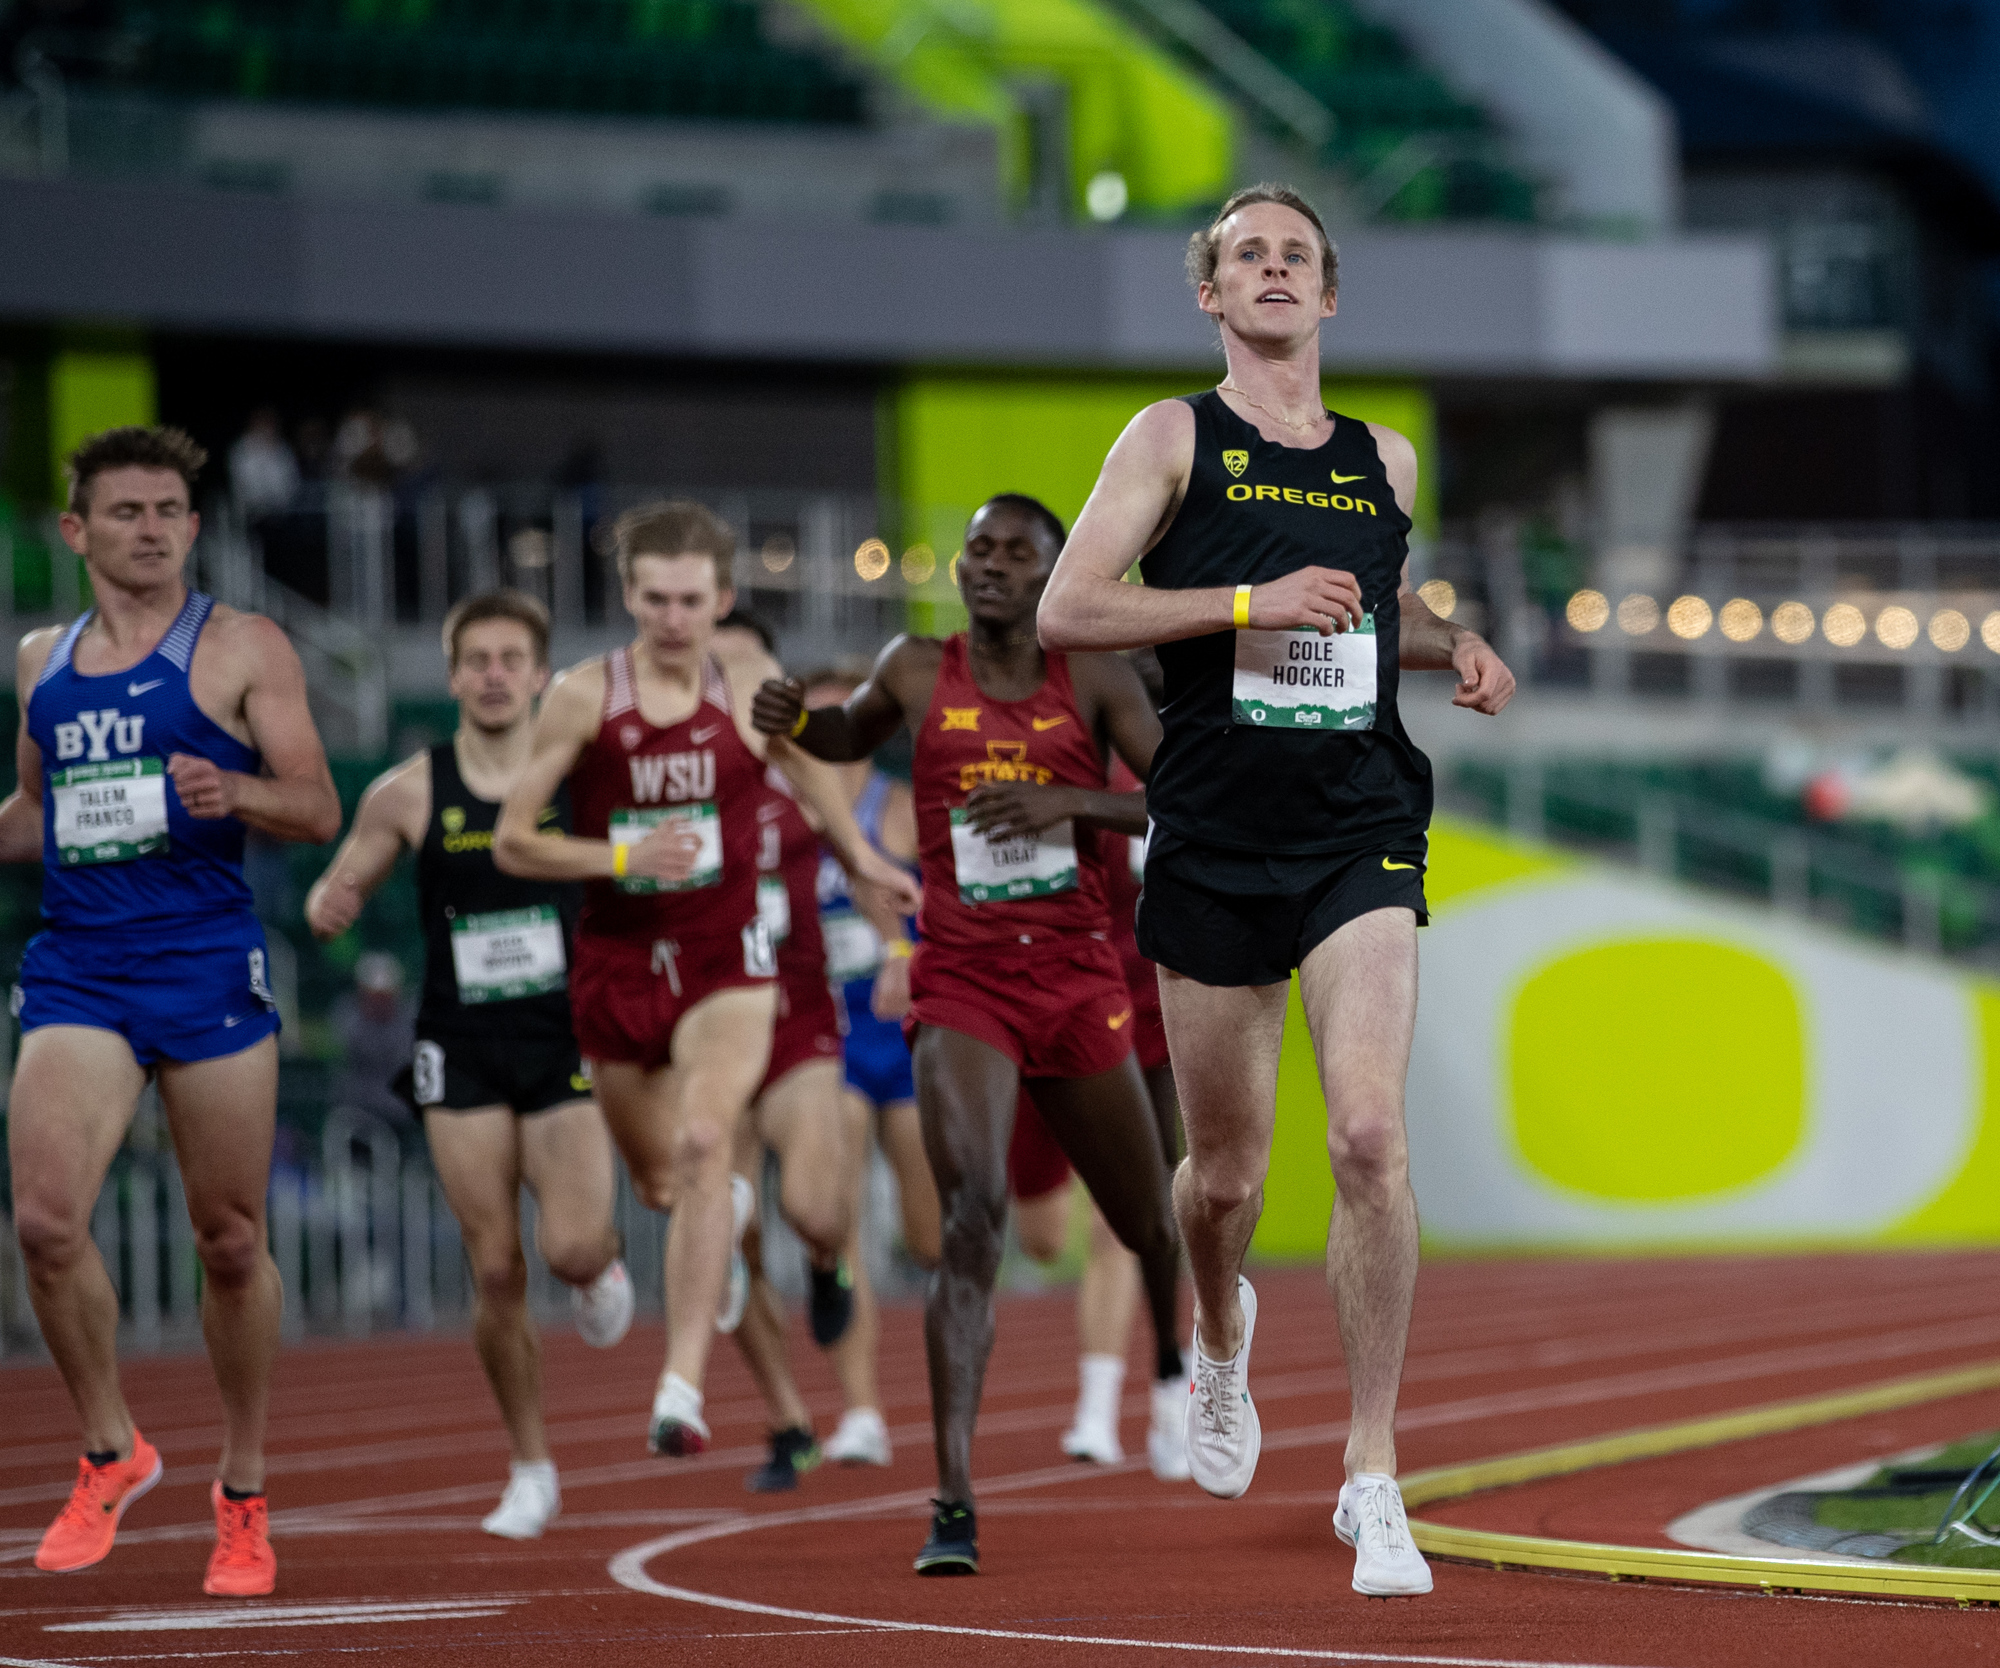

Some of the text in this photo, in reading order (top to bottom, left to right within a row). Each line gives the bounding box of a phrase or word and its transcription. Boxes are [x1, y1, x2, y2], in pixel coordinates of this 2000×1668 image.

[1230, 460, 1243, 472] 12
[1226, 483, 1378, 516] OREGON
[1288, 640, 1333, 662] COLE
[1272, 665, 1345, 688] HOCKER
[55, 709, 145, 762] BYU
[629, 751, 716, 804] WSU
[78, 788, 128, 808] TALEM
[75, 808, 135, 830] FRANCO
